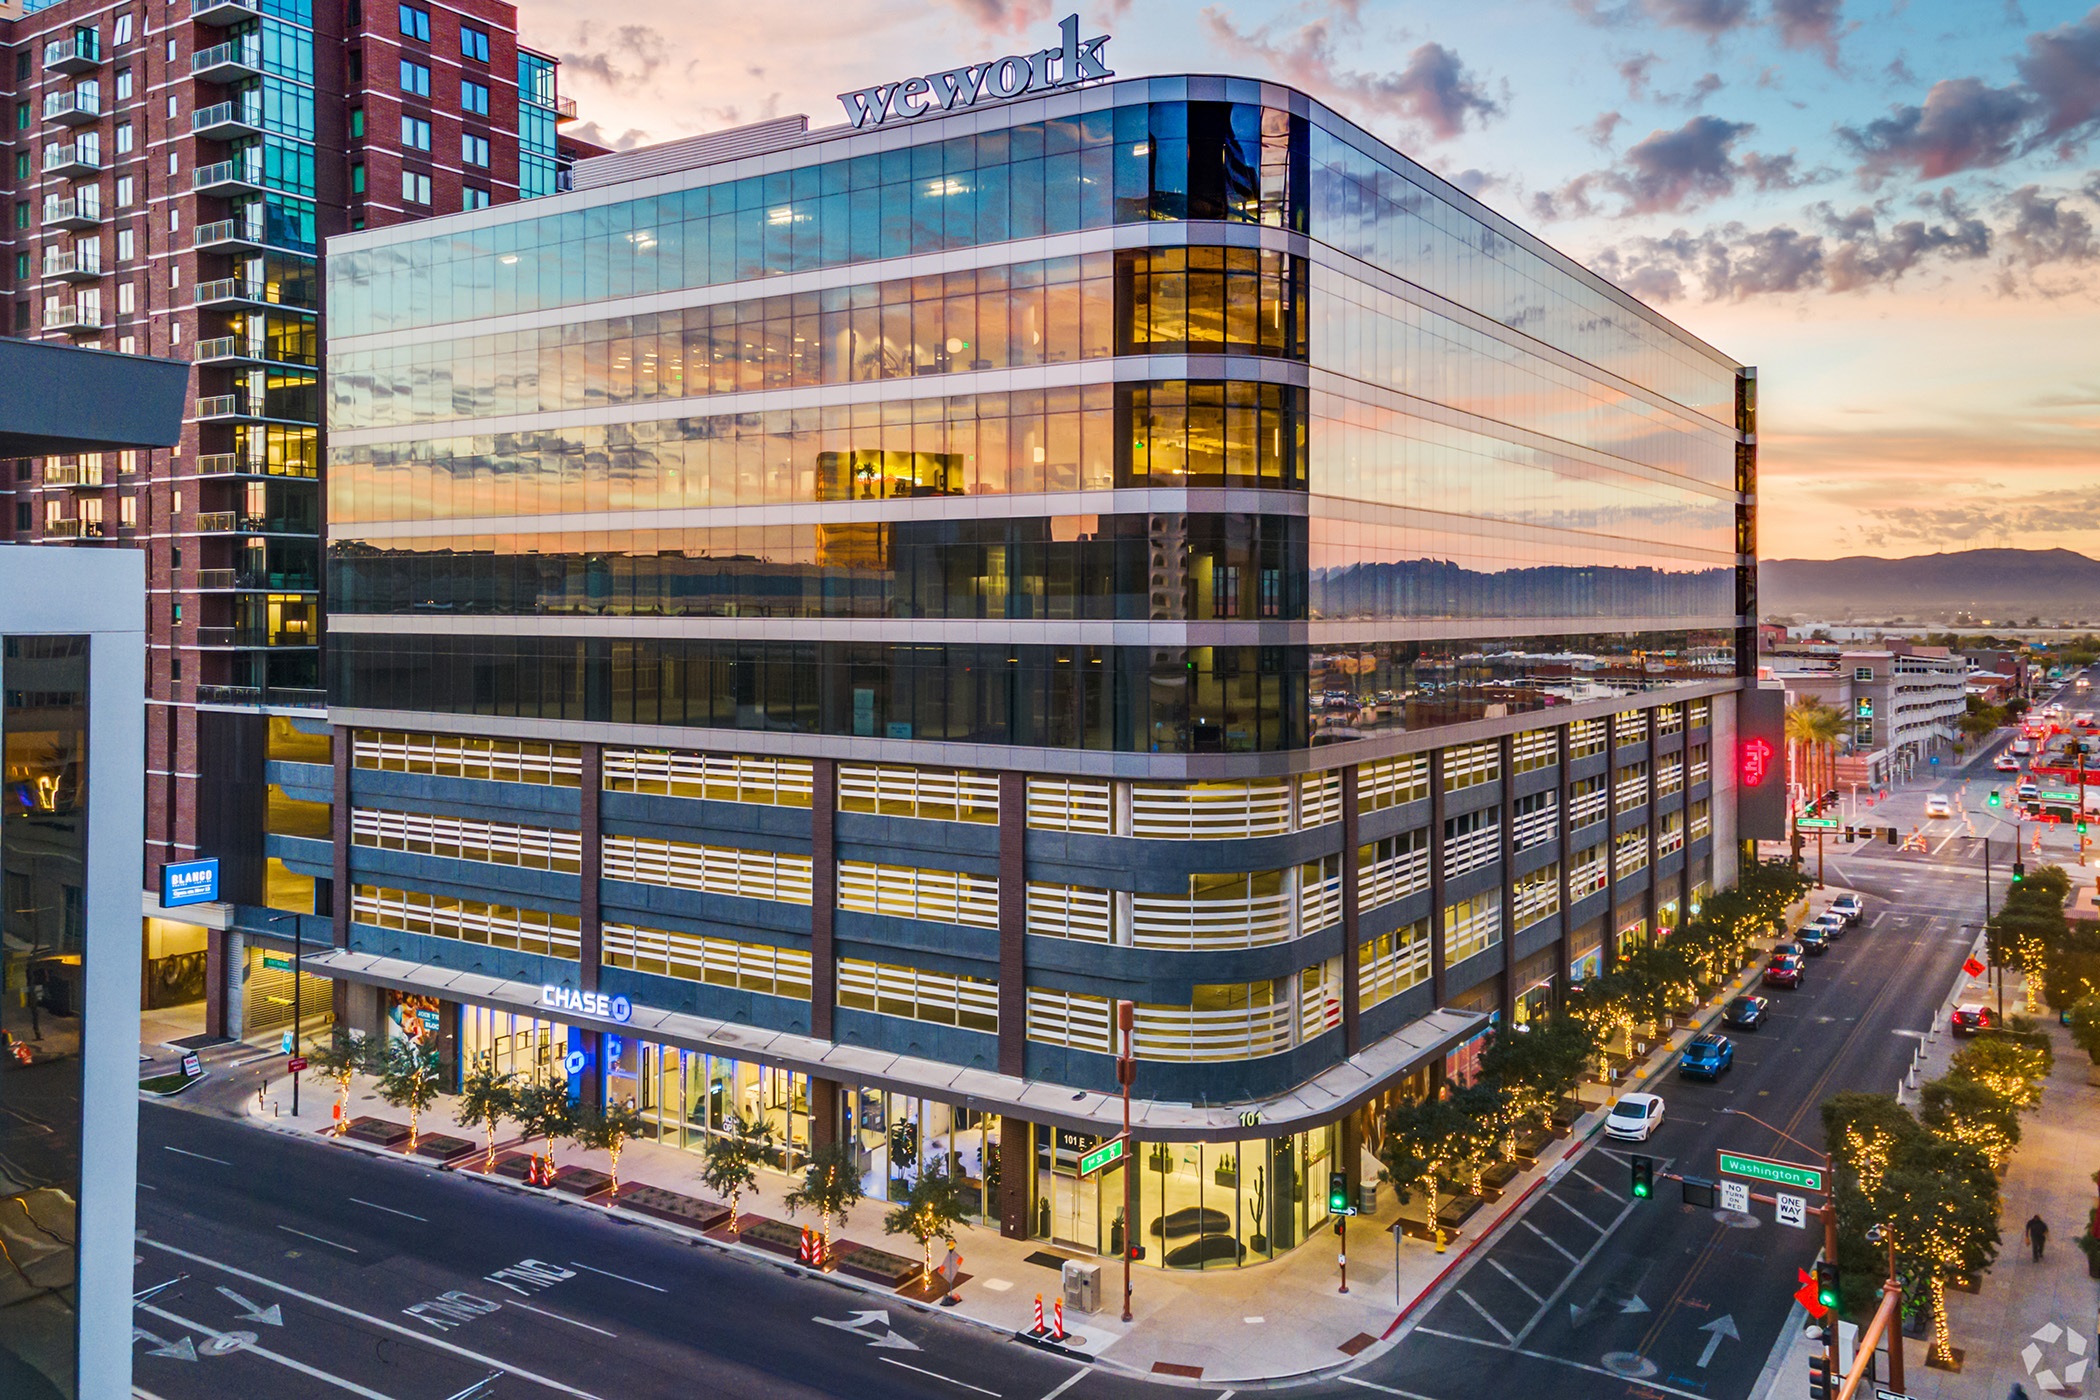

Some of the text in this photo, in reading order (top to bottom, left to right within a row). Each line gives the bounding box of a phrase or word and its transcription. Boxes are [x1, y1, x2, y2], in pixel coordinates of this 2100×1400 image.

[837, 13, 1116, 129] wework
[171, 869, 213, 885] BLANCO
[542, 985, 610, 1016] CHASE
[1239, 1111, 1261, 1127] 101
[1064, 1134, 1077, 1146] 101
[1729, 1160, 1800, 1182] Washington
[1725, 1190, 1744, 1199] TURN
[1728, 1184, 1742, 1192] NO
[1781, 1196, 1801, 1207] ONE
[1780, 1204, 1801, 1216] WAY
[401, 1289, 503, 1332] ONLY
